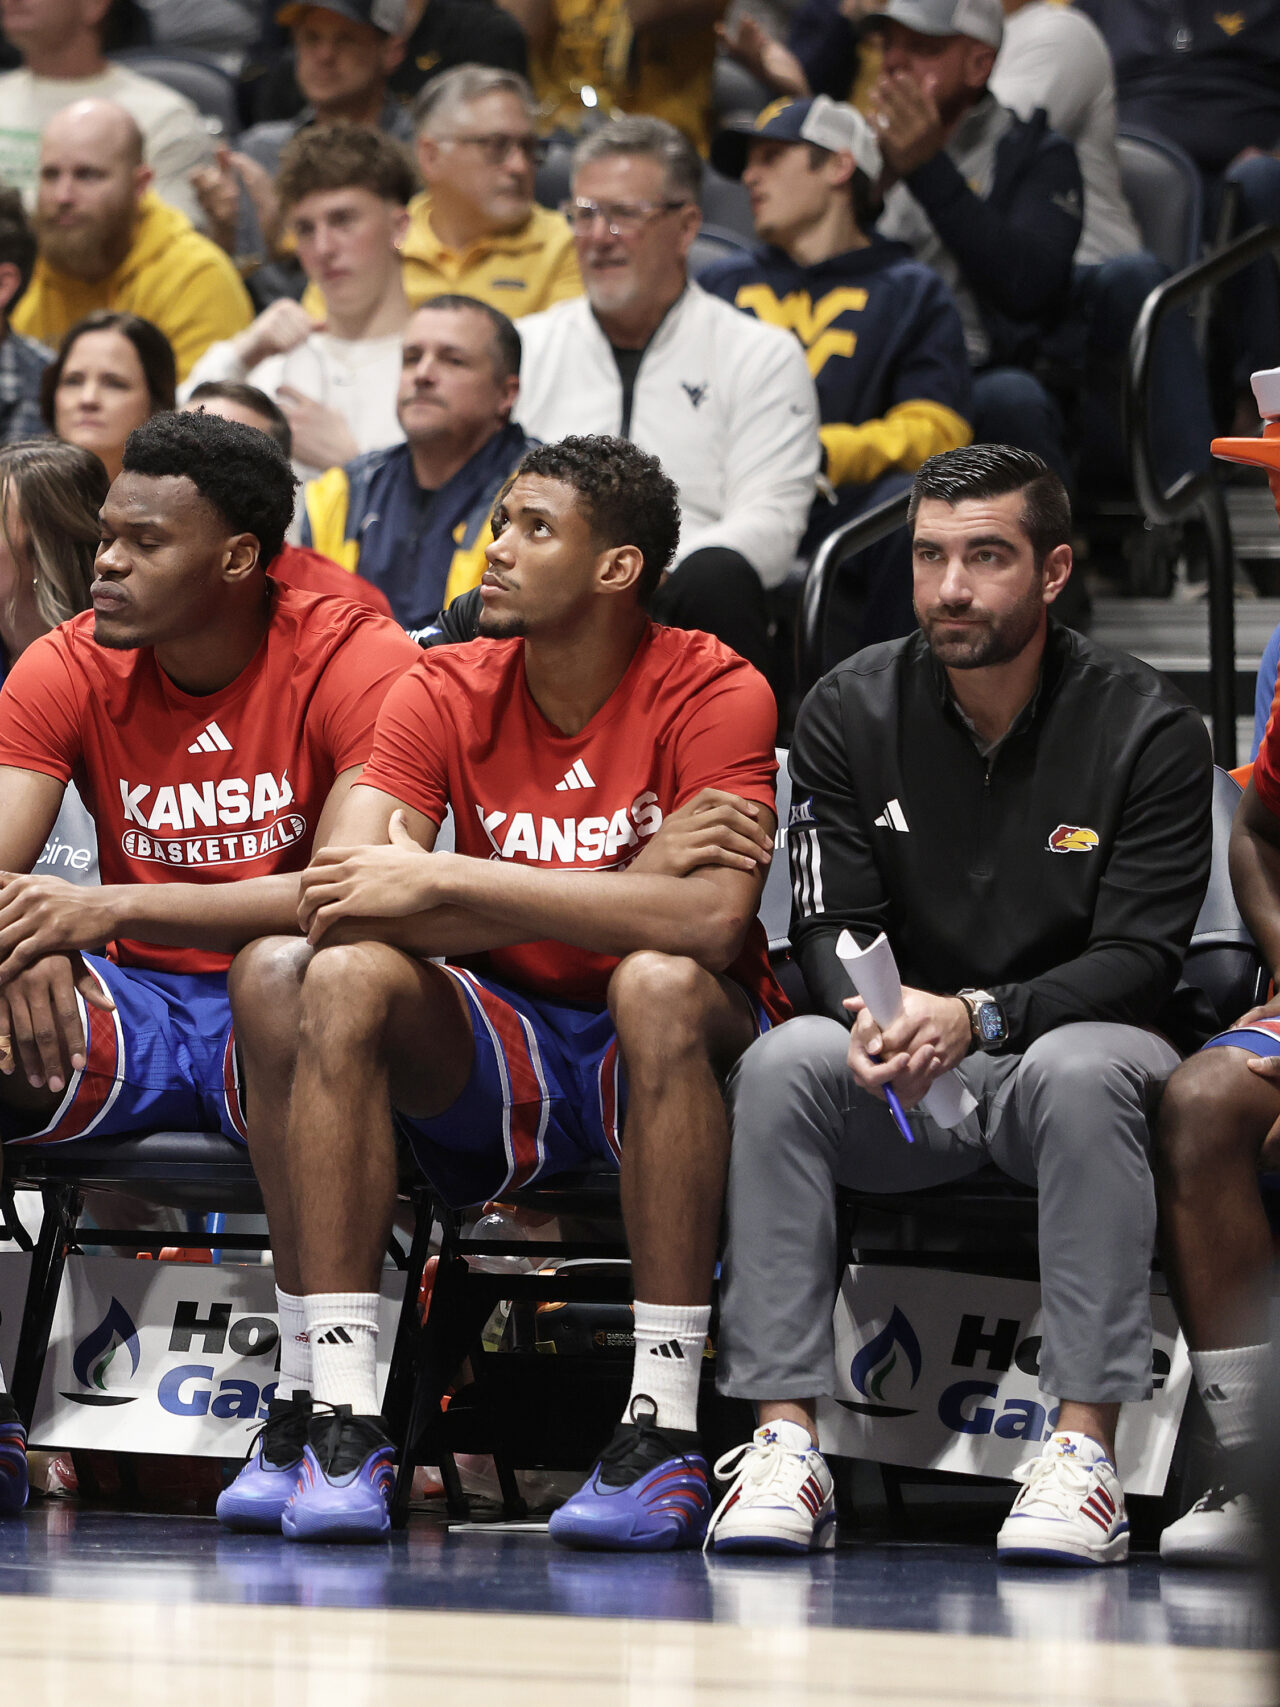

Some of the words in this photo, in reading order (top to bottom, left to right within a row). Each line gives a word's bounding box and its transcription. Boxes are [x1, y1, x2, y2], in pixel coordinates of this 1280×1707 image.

[136, 819, 294, 864] BASKETBALL
[475, 790, 663, 863] KANSAS
[168, 1301, 282, 1372] Ho
